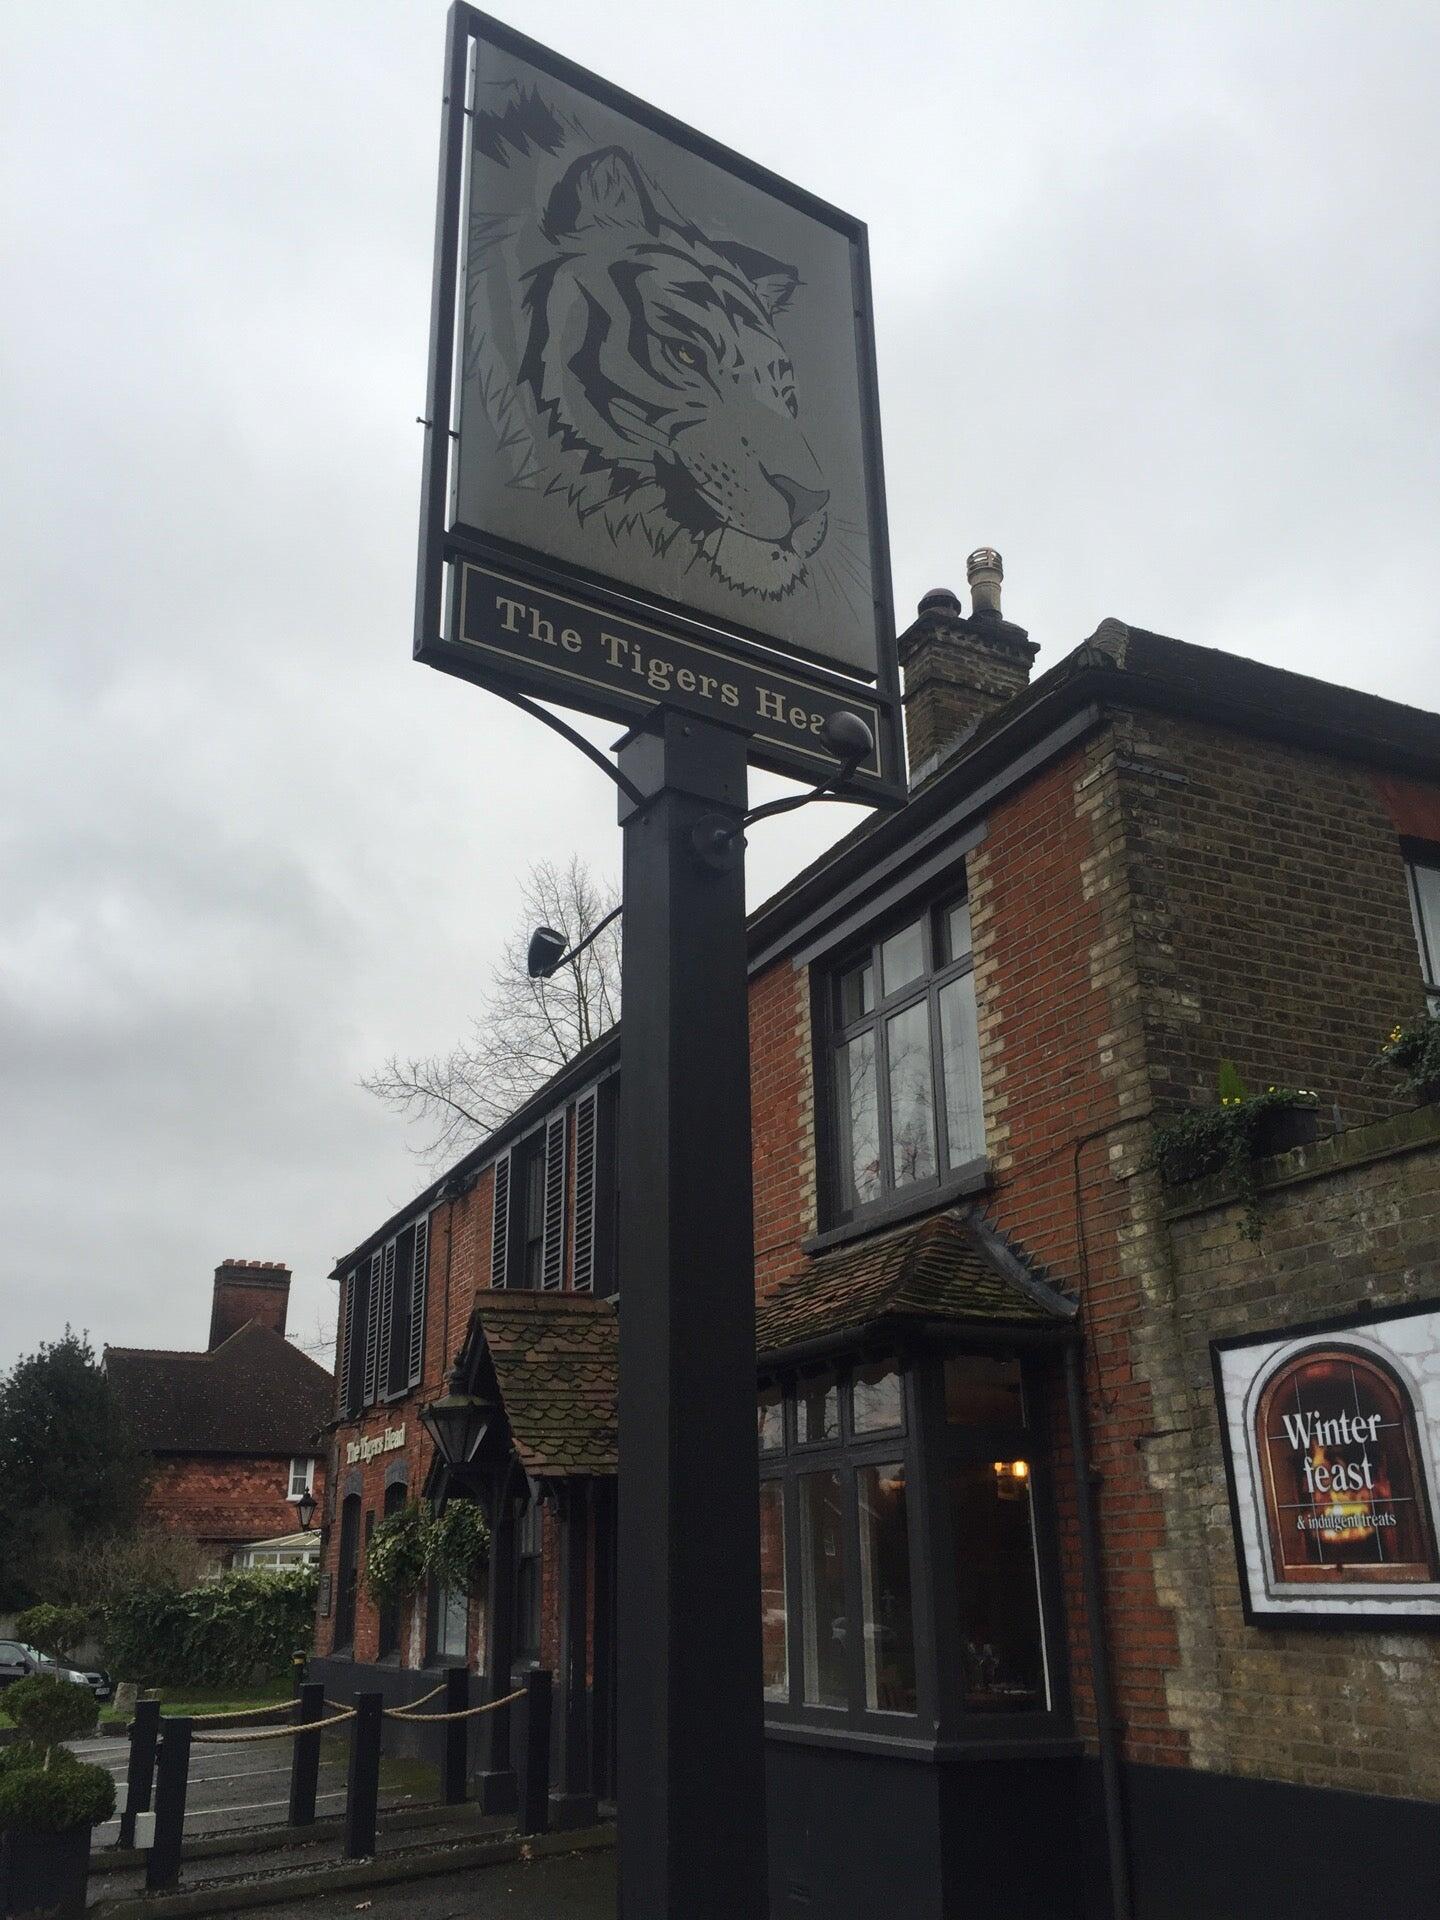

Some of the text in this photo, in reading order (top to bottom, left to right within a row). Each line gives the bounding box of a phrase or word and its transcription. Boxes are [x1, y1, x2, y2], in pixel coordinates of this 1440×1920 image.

[496, 596, 826, 735] The Tigers Hea
[347, 1423, 405, 1464] The Tigers Head
[1282, 1409, 1381, 1450] Winter
[1303, 1455, 1375, 1493] feast
[1297, 1511, 1397, 1531] & indulgent treats
